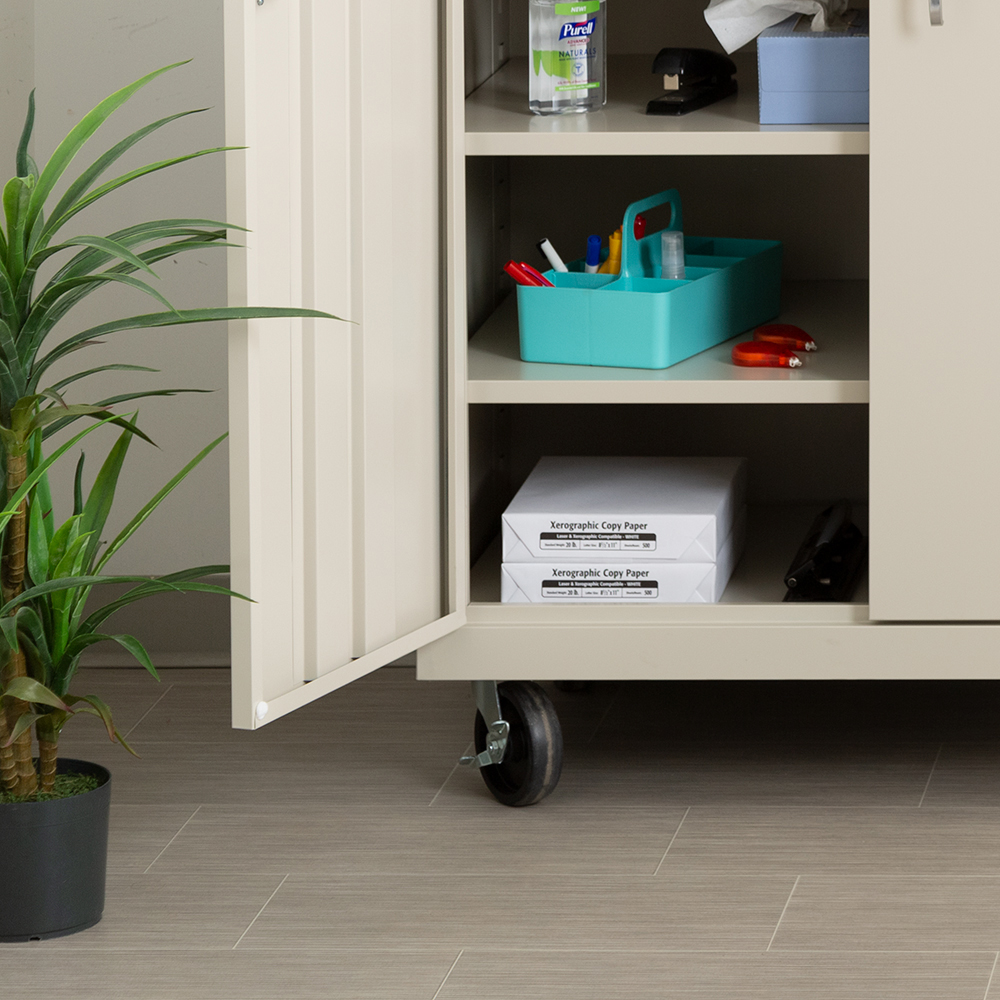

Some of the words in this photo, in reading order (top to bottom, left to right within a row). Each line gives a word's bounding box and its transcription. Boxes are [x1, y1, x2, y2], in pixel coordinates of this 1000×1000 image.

[564, 22, 593, 36] Purell
[559, 47, 596, 57] NATURALS
[550, 521, 599, 531] Xerographic
[601, 521, 621, 531] Copy
[624, 522, 648, 531] Paper
[552, 568, 600, 579] Xerographic
[603, 569, 623, 579] Copy
[626, 569, 649, 579] Paper
